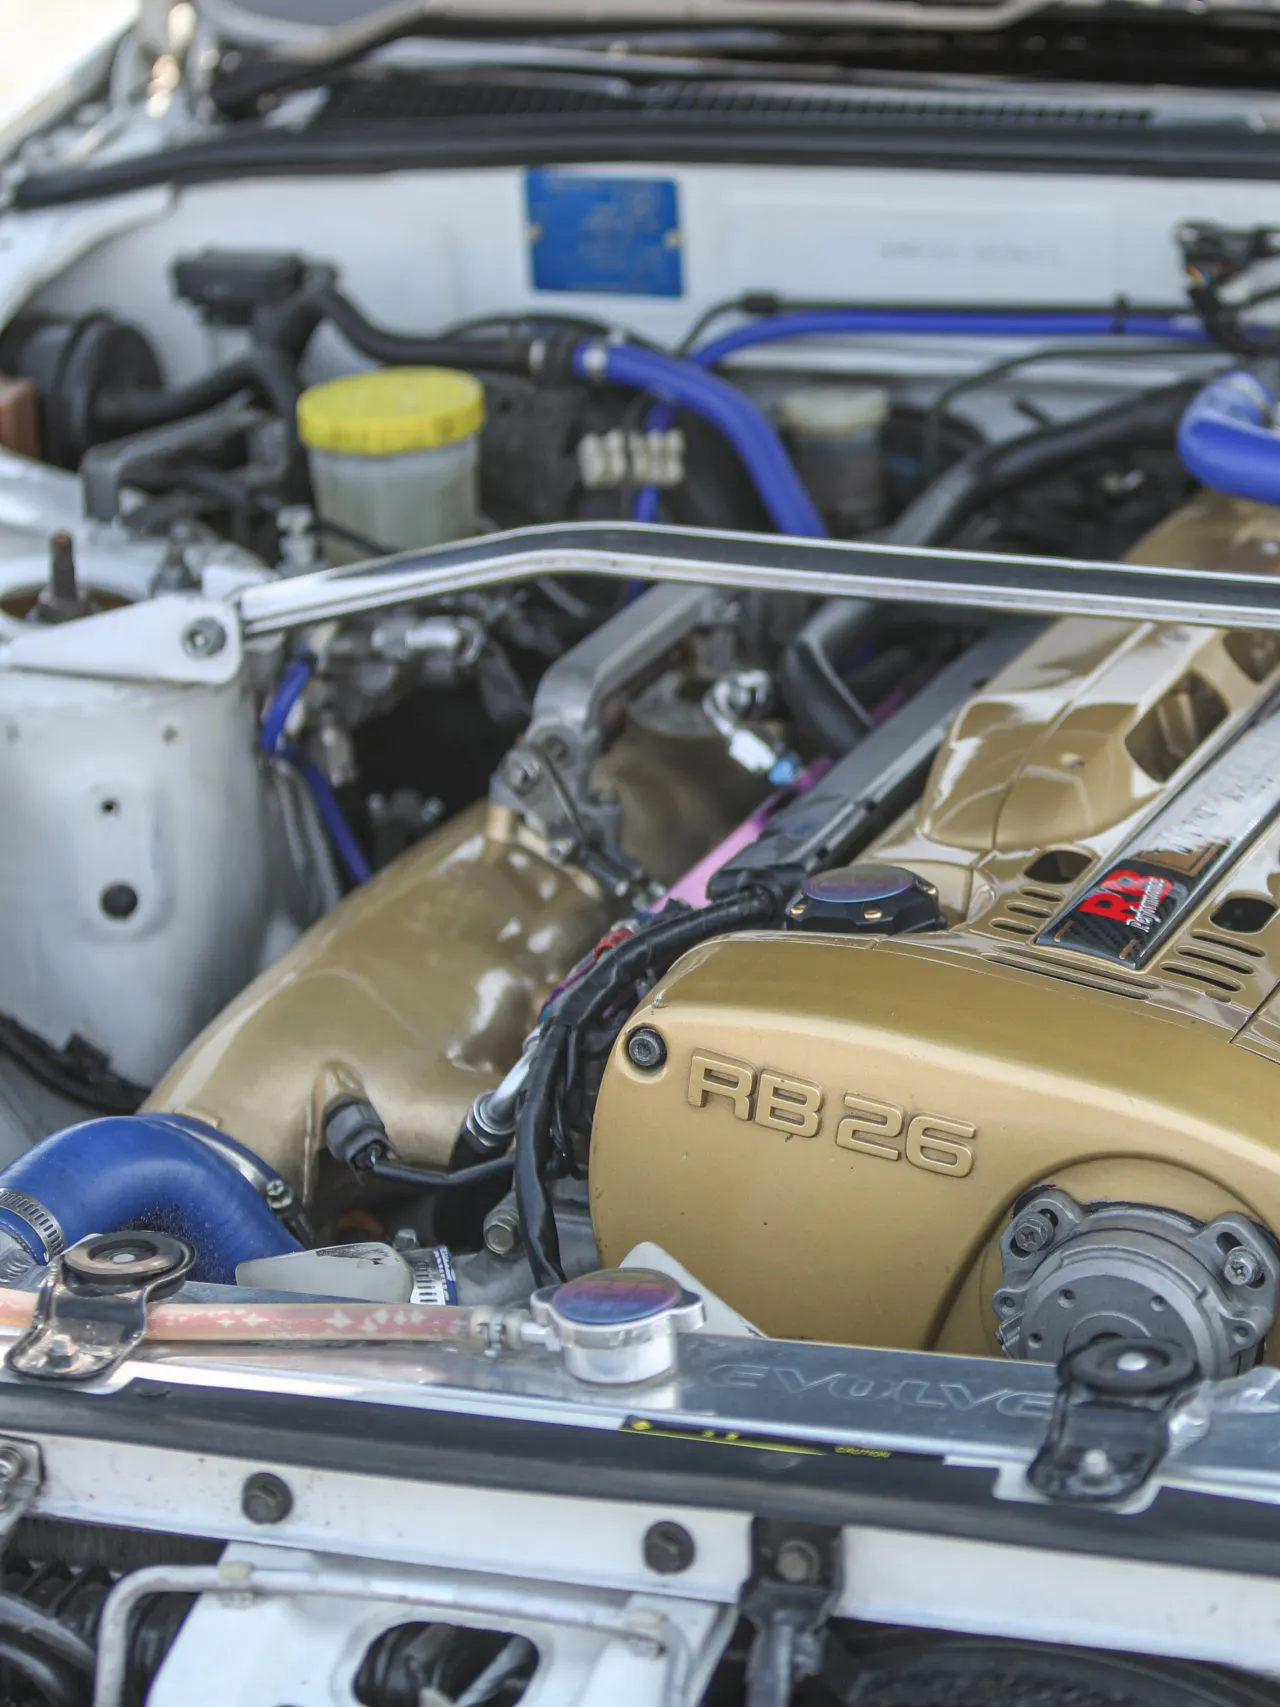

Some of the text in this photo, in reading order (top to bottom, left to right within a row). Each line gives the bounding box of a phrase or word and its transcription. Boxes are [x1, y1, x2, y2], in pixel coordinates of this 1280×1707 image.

[1077, 869, 1173, 924] RB
[687, 1047, 978, 1178] RB 26
[706, 1363, 1057, 1420] EVOLVE
